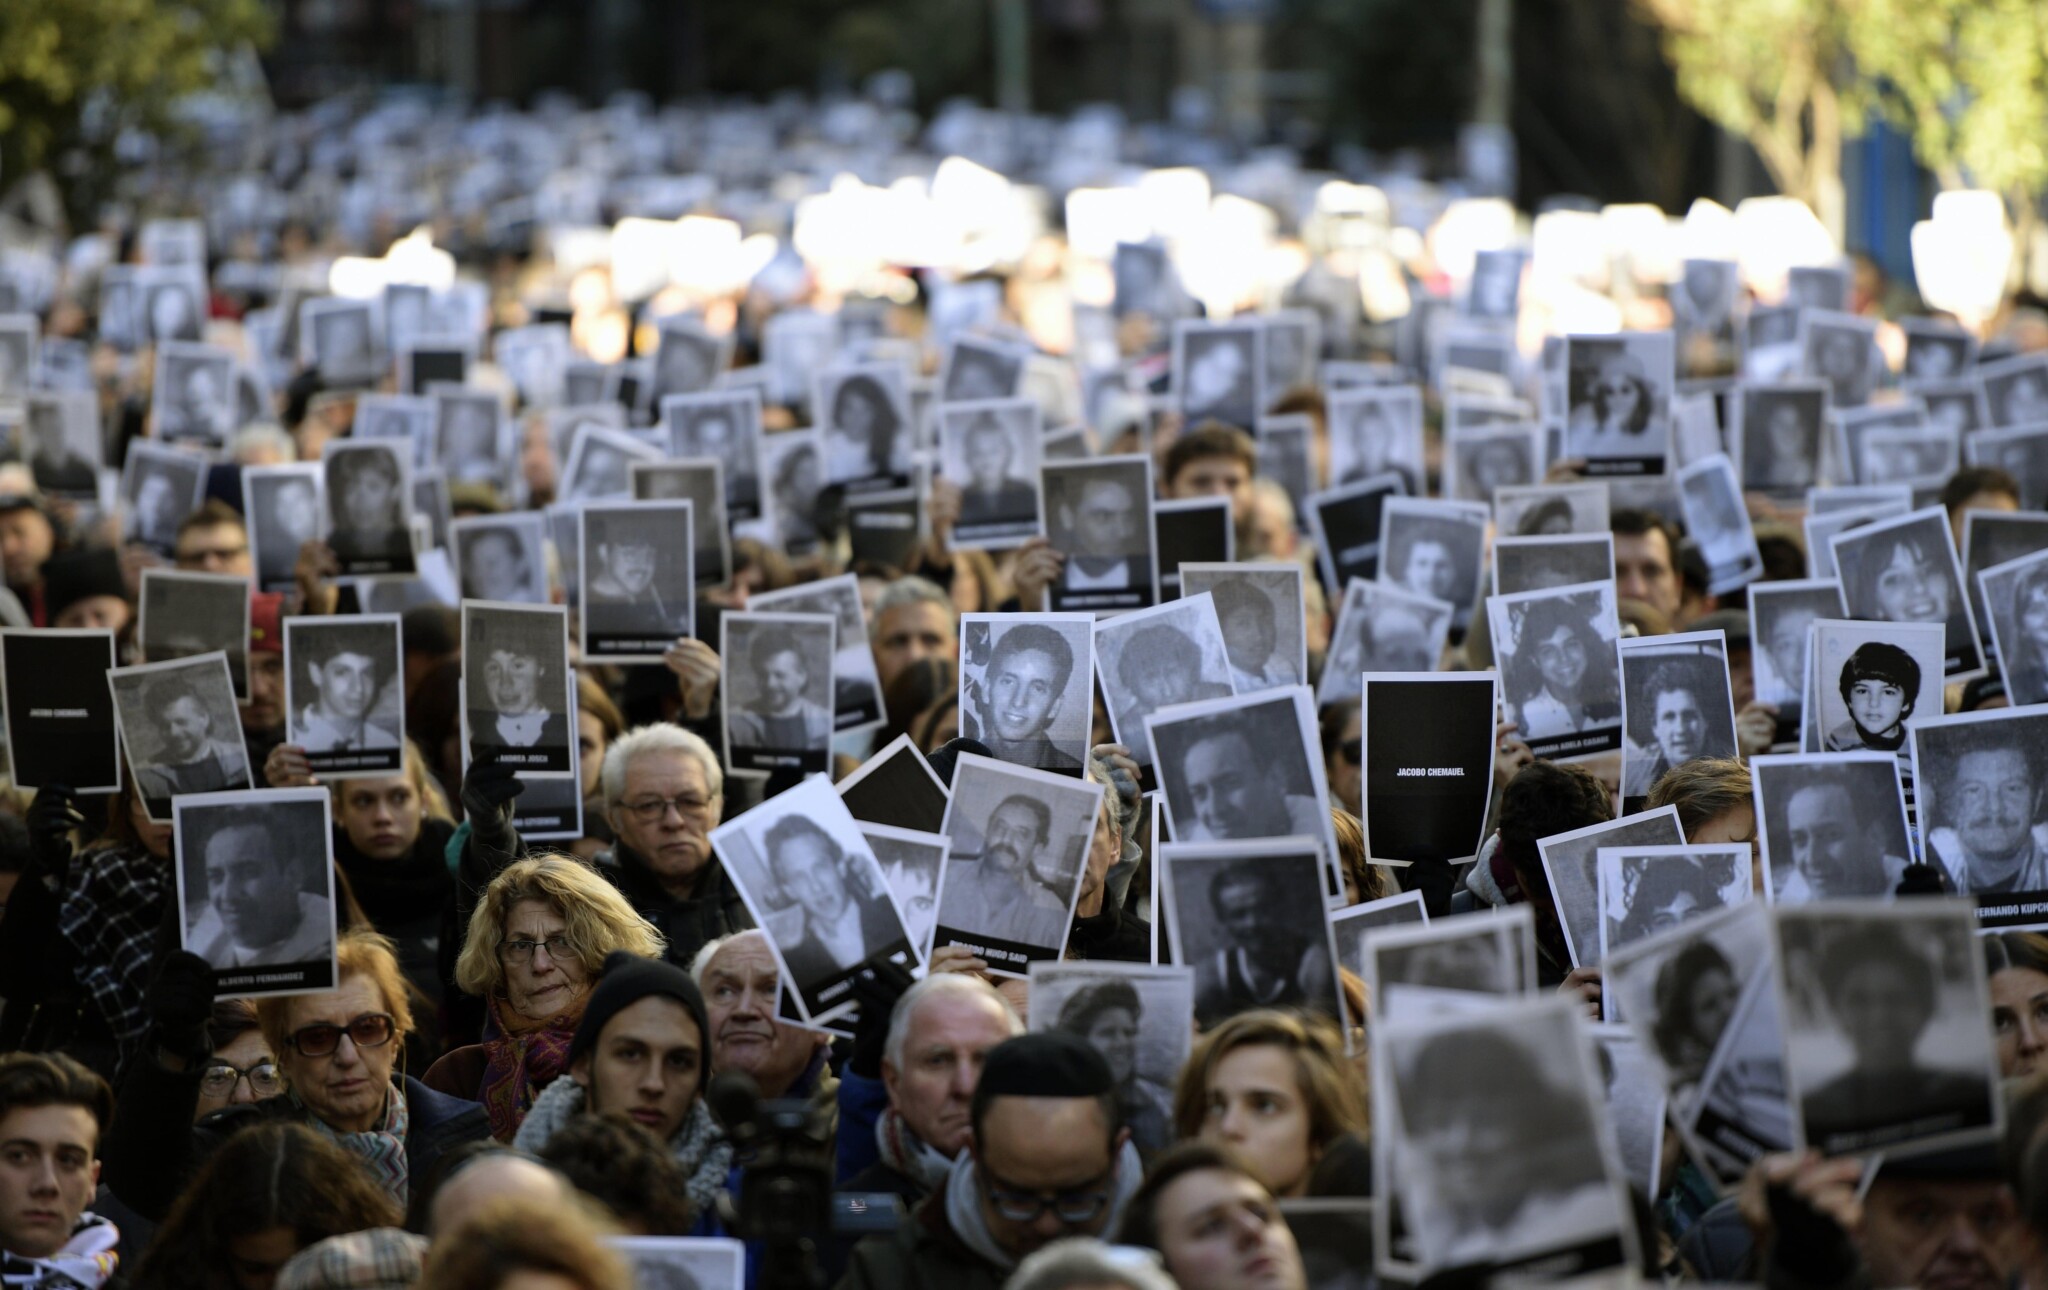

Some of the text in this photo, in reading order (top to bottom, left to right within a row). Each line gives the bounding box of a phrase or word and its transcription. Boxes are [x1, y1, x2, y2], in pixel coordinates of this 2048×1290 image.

[1533, 743, 1560, 755] VIVIANA
[1560, 739, 1583, 751] ADELA
[1397, 767, 1465, 777] JACOBO CHEMAUEL
[1974, 904, 2020, 919] FERNANDO
[984, 948, 1008, 960] HUGO
[1008, 952, 1028, 964] SAID
[217, 972, 305, 987] ALBERTO FERNANDEZ
